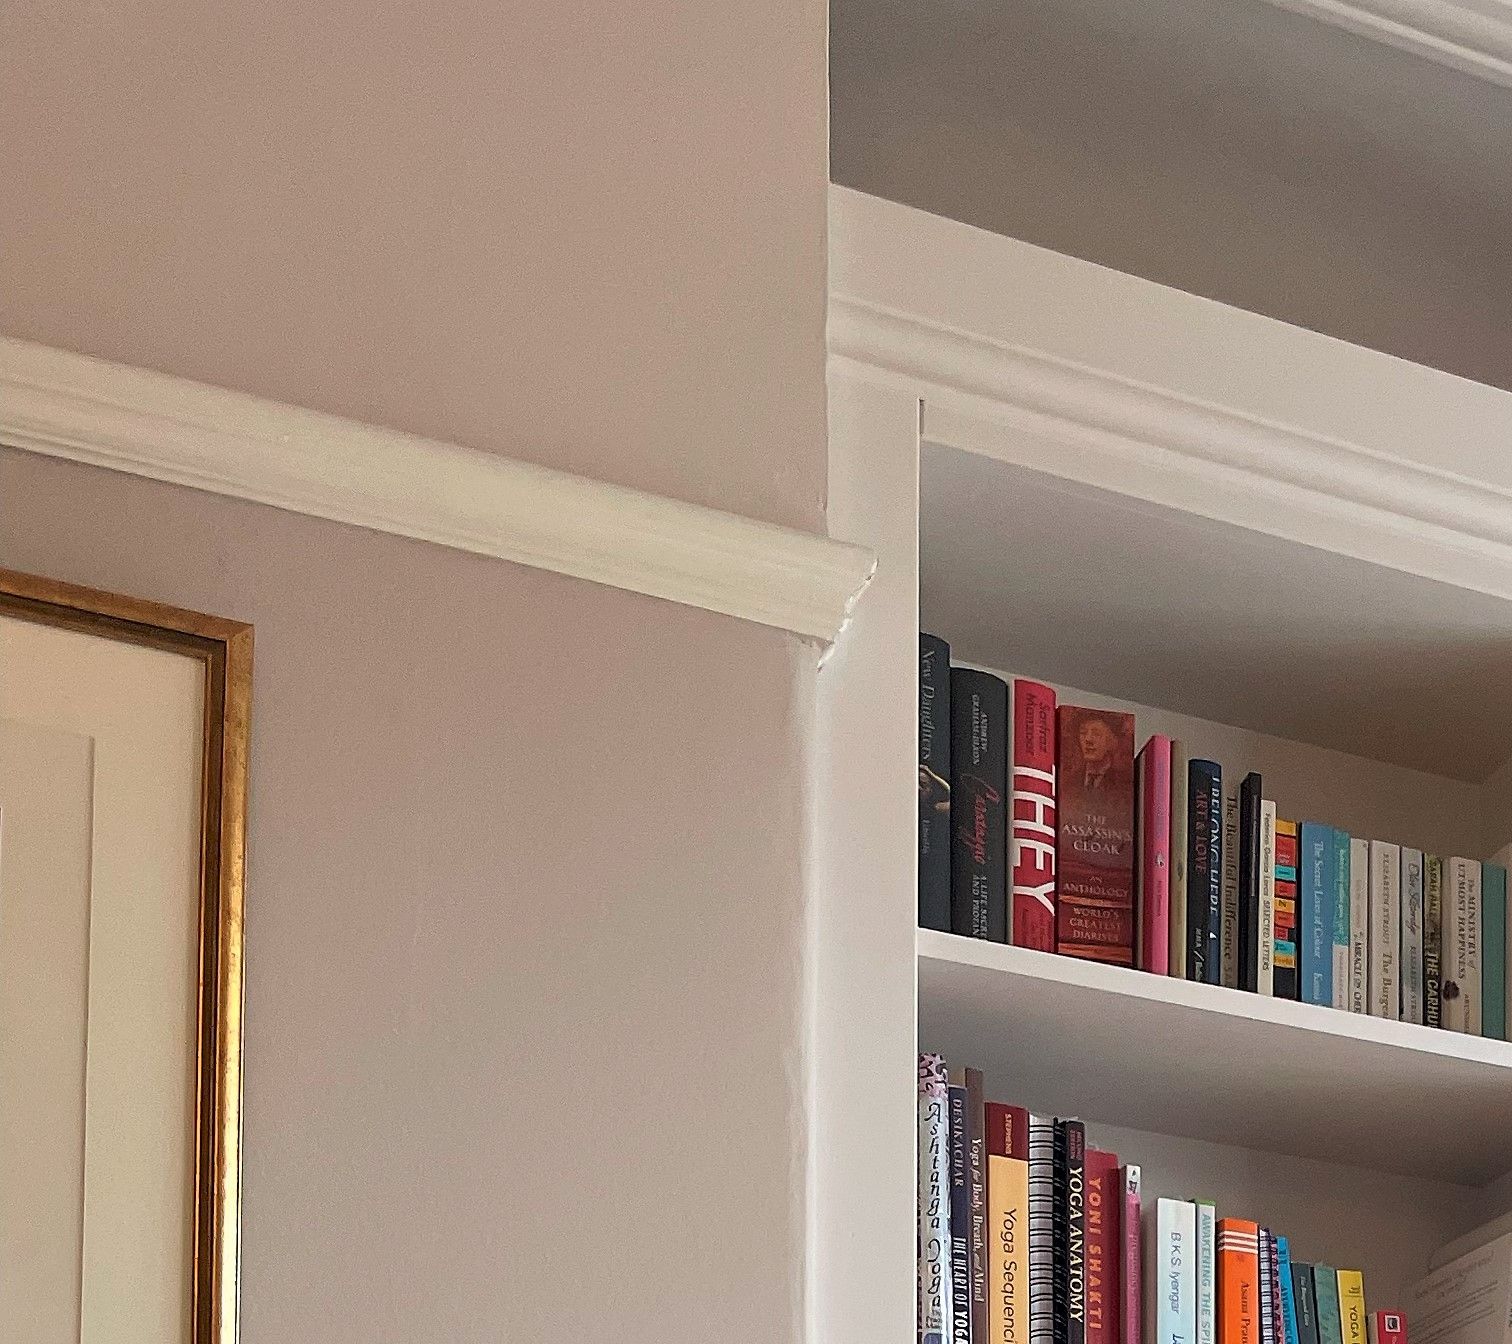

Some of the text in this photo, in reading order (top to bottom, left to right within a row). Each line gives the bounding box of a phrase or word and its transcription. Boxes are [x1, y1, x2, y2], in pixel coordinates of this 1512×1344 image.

[980, 711, 988, 752] ANDREW
[1195, 789, 1207, 815] ART
[1086, 815, 1107, 824] THE
[1013, 765, 1056, 916] THEY
[1074, 841, 1120, 855] CLOAK
[1195, 836, 1207, 874] LOVE
[1314, 841, 1323, 857] The
[1063, 883, 1129, 897] ANTHOLOGY
[1225, 796, 1237, 960] The Beautiful Indifference
[1314, 860, 1323, 886] Secret
[1458, 863, 1466, 980] UTMOST HAPPINESS
[1468, 896, 1476, 956] MINISTRY
[1314, 928, 1322, 958] Colour
[1382, 952, 1392, 974] The
[1427, 951, 1437, 975] THE
[952, 1098, 964, 1187] DESIKACHAR
[1004, 1113, 1012, 1155] STEPHENS
[926, 1102, 943, 1230] Ashtanga
[970, 1138, 982, 1166] Yoga
[1089, 1177, 1101, 1234] YONI
[953, 1237, 967, 1255] THE
[1001, 1208, 1018, 1254] Yoga
[1069, 1166, 1083, 1322] YOGA ANATOMY
[1200, 1213, 1212, 1288] AWAKENING
[953, 1257, 967, 1291] HEART
[973, 1271, 985, 1302] Mind
[1089, 1245, 1102, 1330] SHAKTI
[953, 1293, 968, 1308] OF
[1169, 1271, 1181, 1314] Iyengar
[1201, 1292, 1212, 1317] THE
[1349, 1305, 1360, 1338] YOGA
